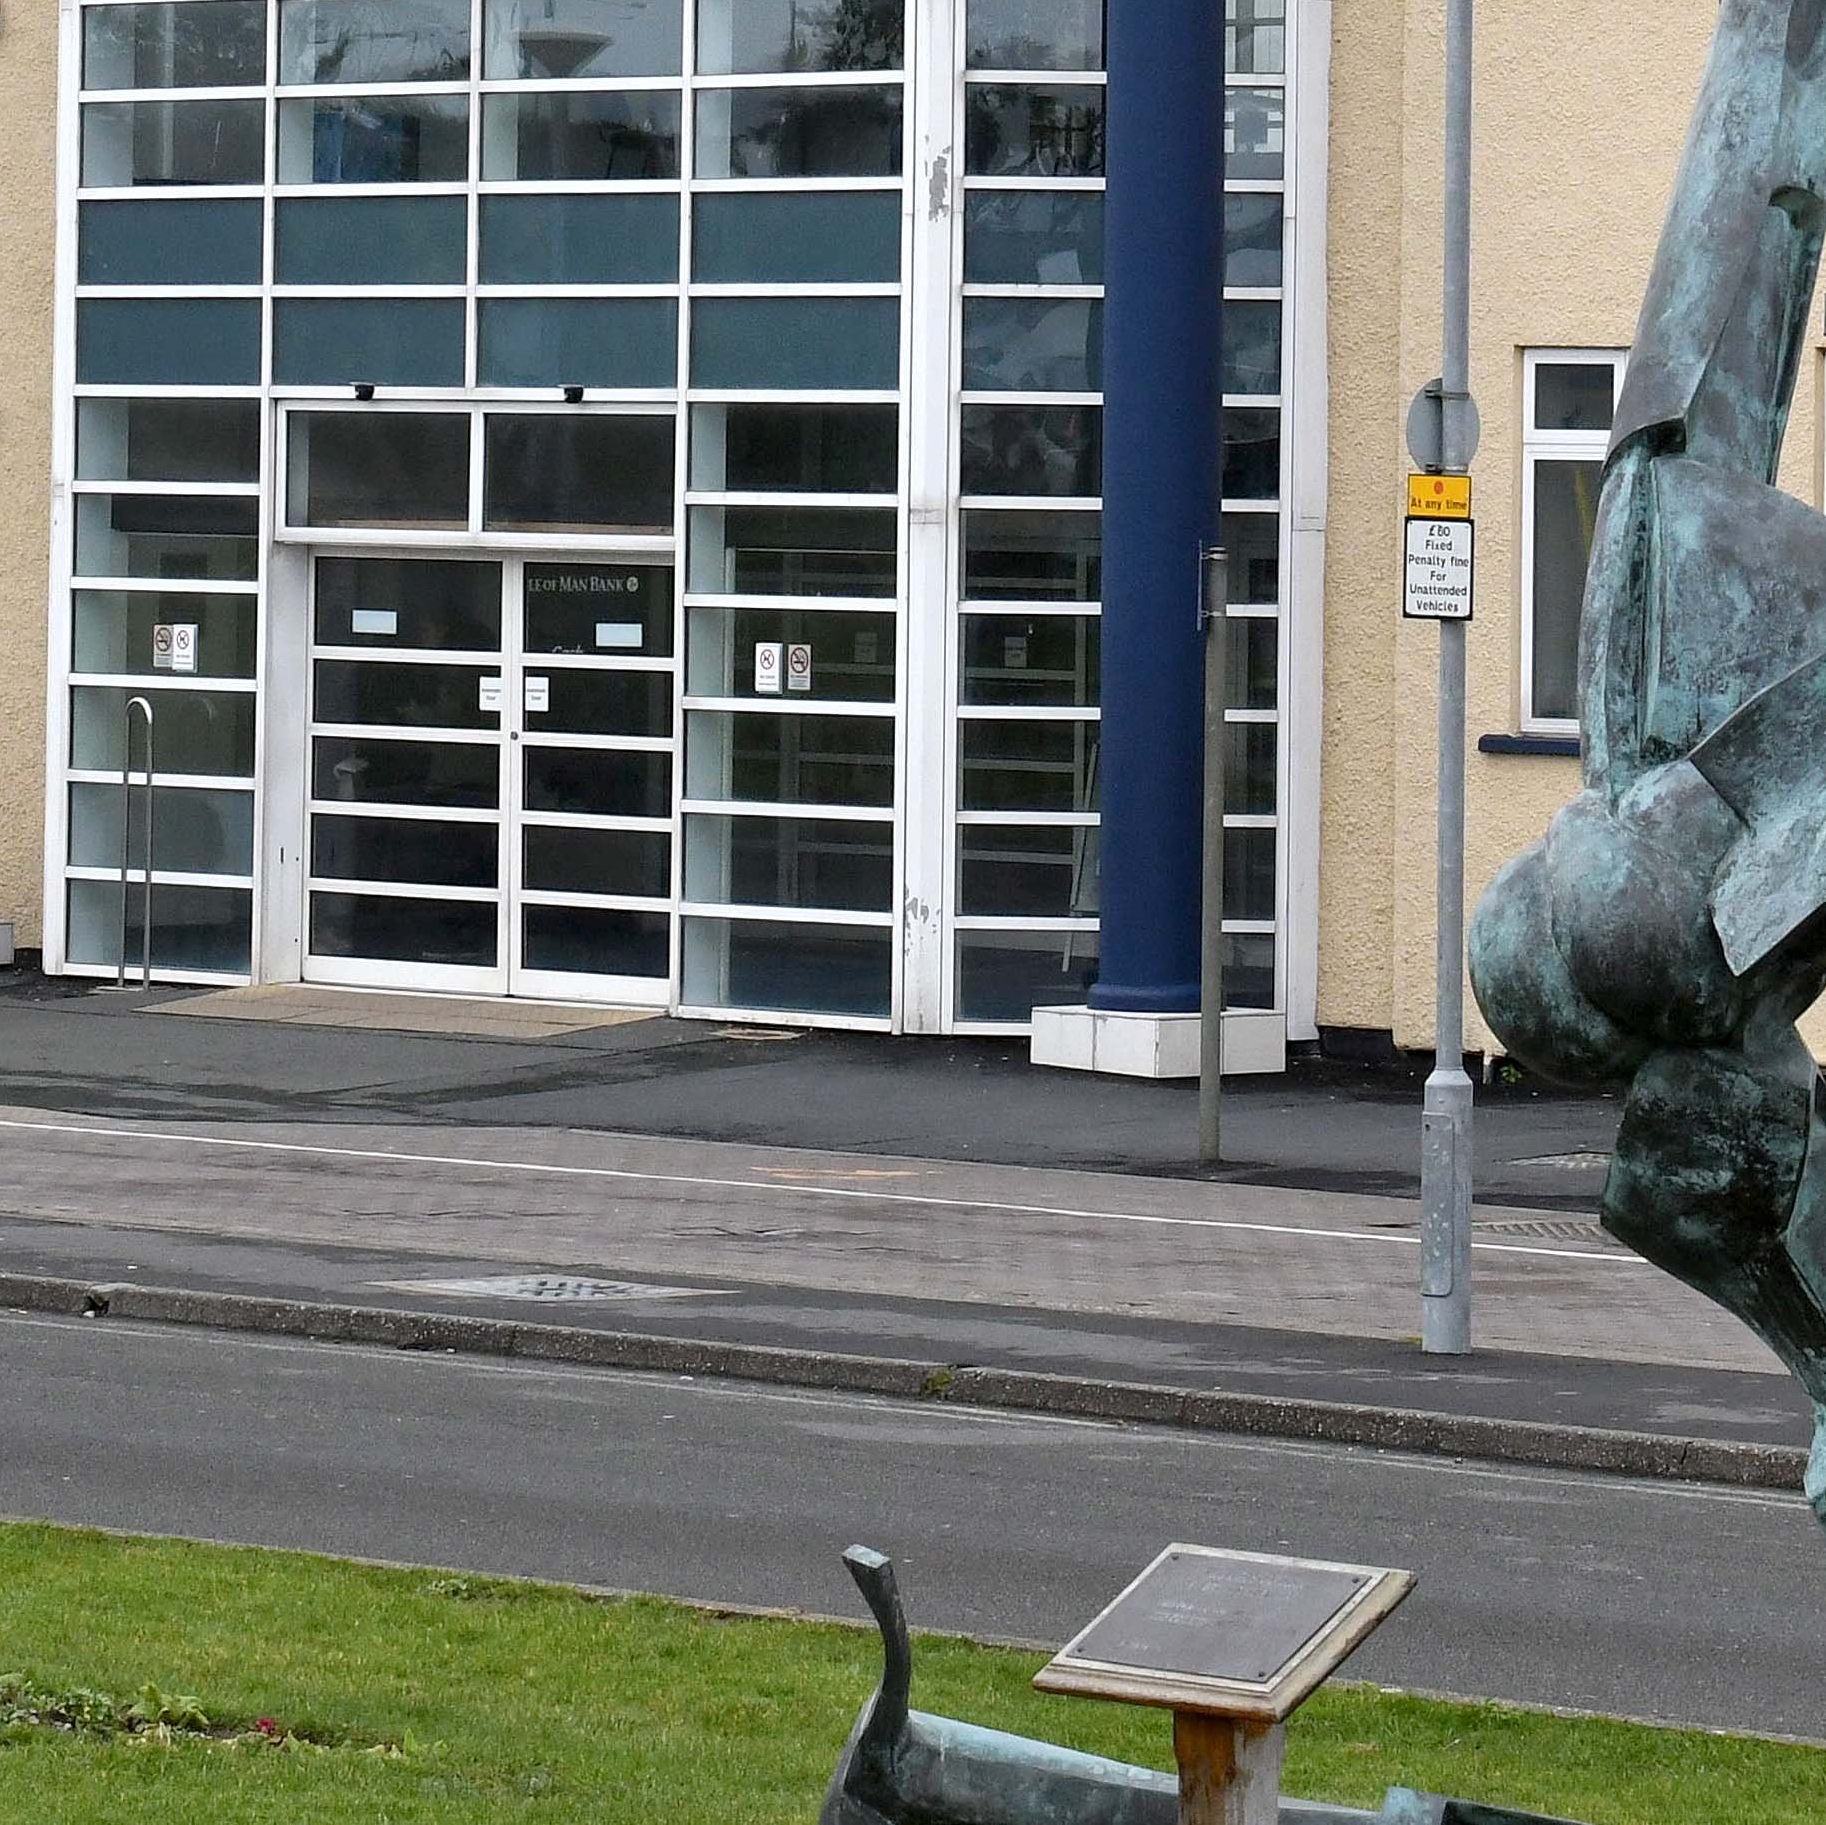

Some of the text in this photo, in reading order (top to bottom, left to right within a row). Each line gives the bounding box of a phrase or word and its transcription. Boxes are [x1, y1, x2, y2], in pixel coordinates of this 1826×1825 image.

[1411, 496, 1467, 511] At any time
[1425, 540, 1453, 551] Fixed
[1408, 554, 1469, 568] Penalty fine
[1430, 571, 1447, 581] For
[1409, 584, 1467, 596] Unattended
[1416, 600, 1459, 612] Vehicles
